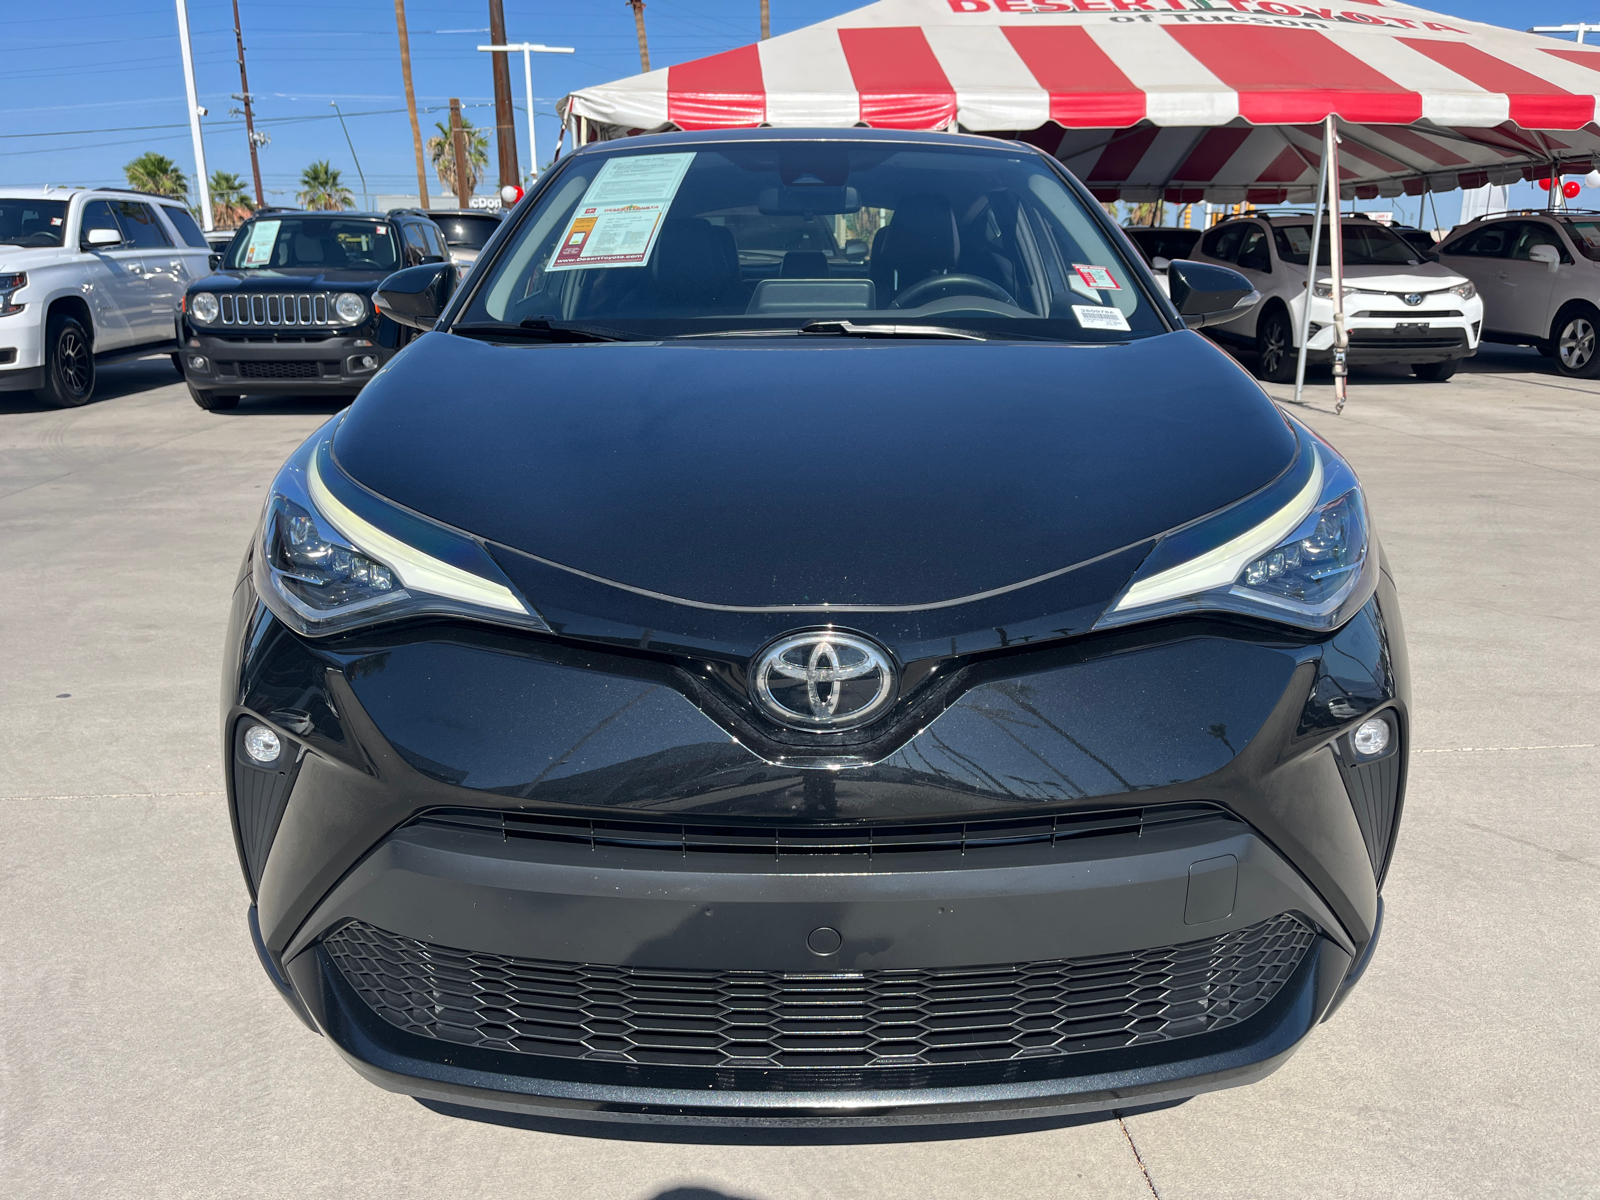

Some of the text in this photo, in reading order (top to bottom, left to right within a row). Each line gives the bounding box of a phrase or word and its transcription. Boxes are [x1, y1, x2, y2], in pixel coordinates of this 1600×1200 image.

[1109, 14, 1331, 29] of Tucson
[1222, 0, 1472, 34] TOYOTA
[469, 198, 502, 208] cDon
